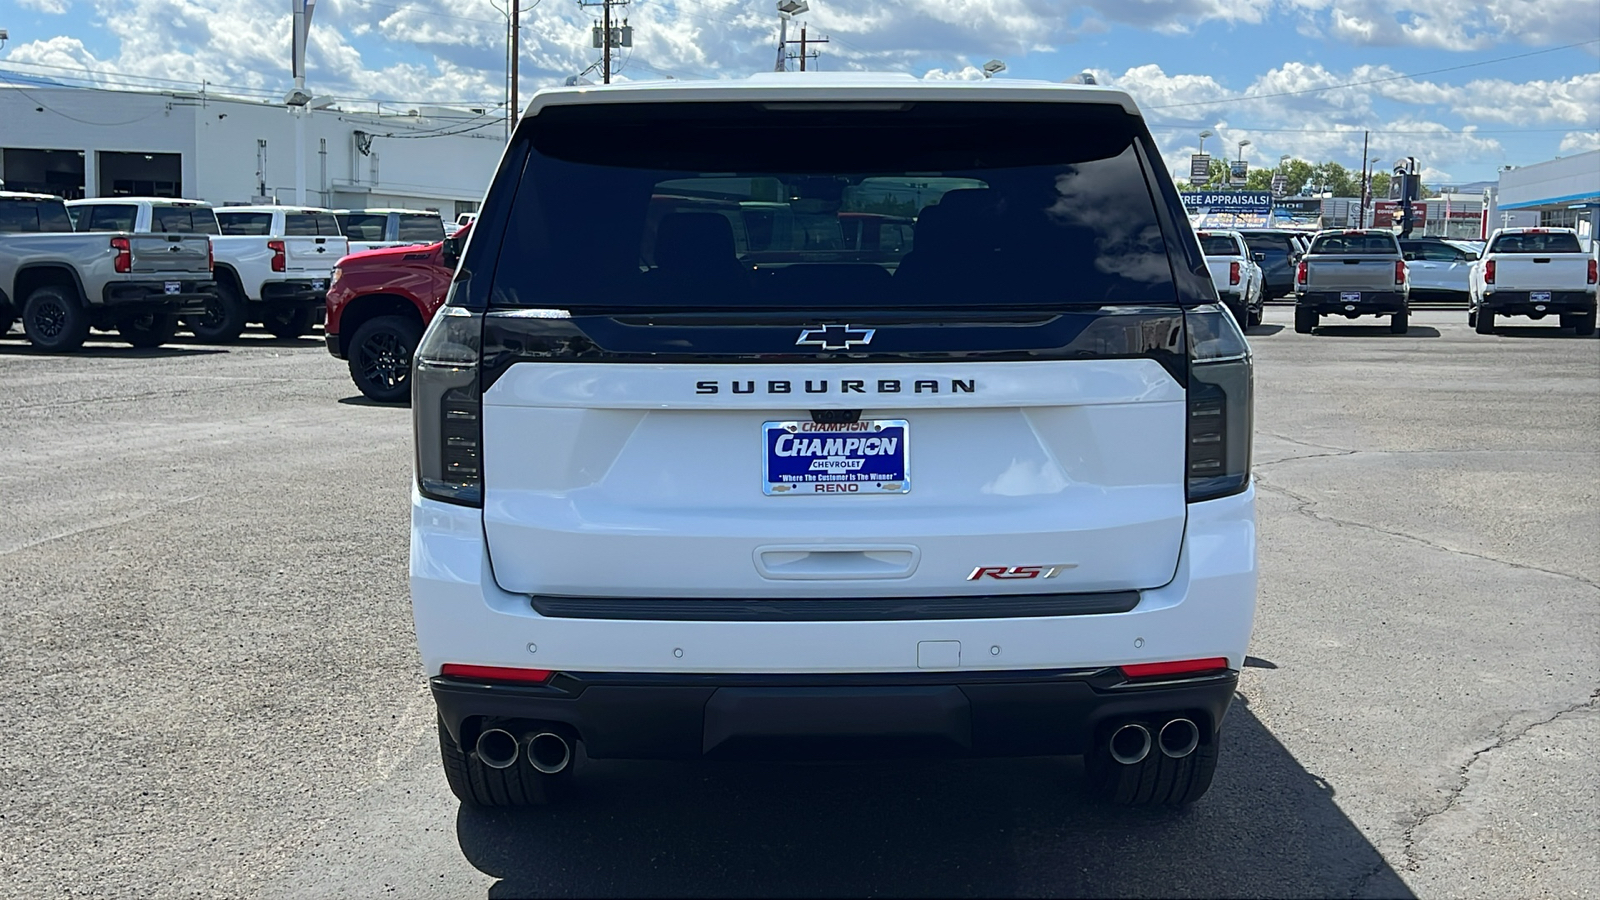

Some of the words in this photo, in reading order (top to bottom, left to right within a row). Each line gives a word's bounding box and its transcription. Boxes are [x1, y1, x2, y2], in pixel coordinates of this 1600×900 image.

[1204, 195, 1269, 205] APPRAISALS!
[695, 379, 975, 395] SUBURBAN
[801, 422, 870, 432] CHAMPION
[774, 434, 898, 457] CHAMPION
[812, 460, 861, 469] CHEVROLET
[804, 474, 816, 482] The
[818, 473, 848, 481] Customer
[849, 473, 856, 481] Is
[857, 473, 869, 481] The
[814, 483, 859, 493] RENO
[966, 563, 1079, 581] RST
